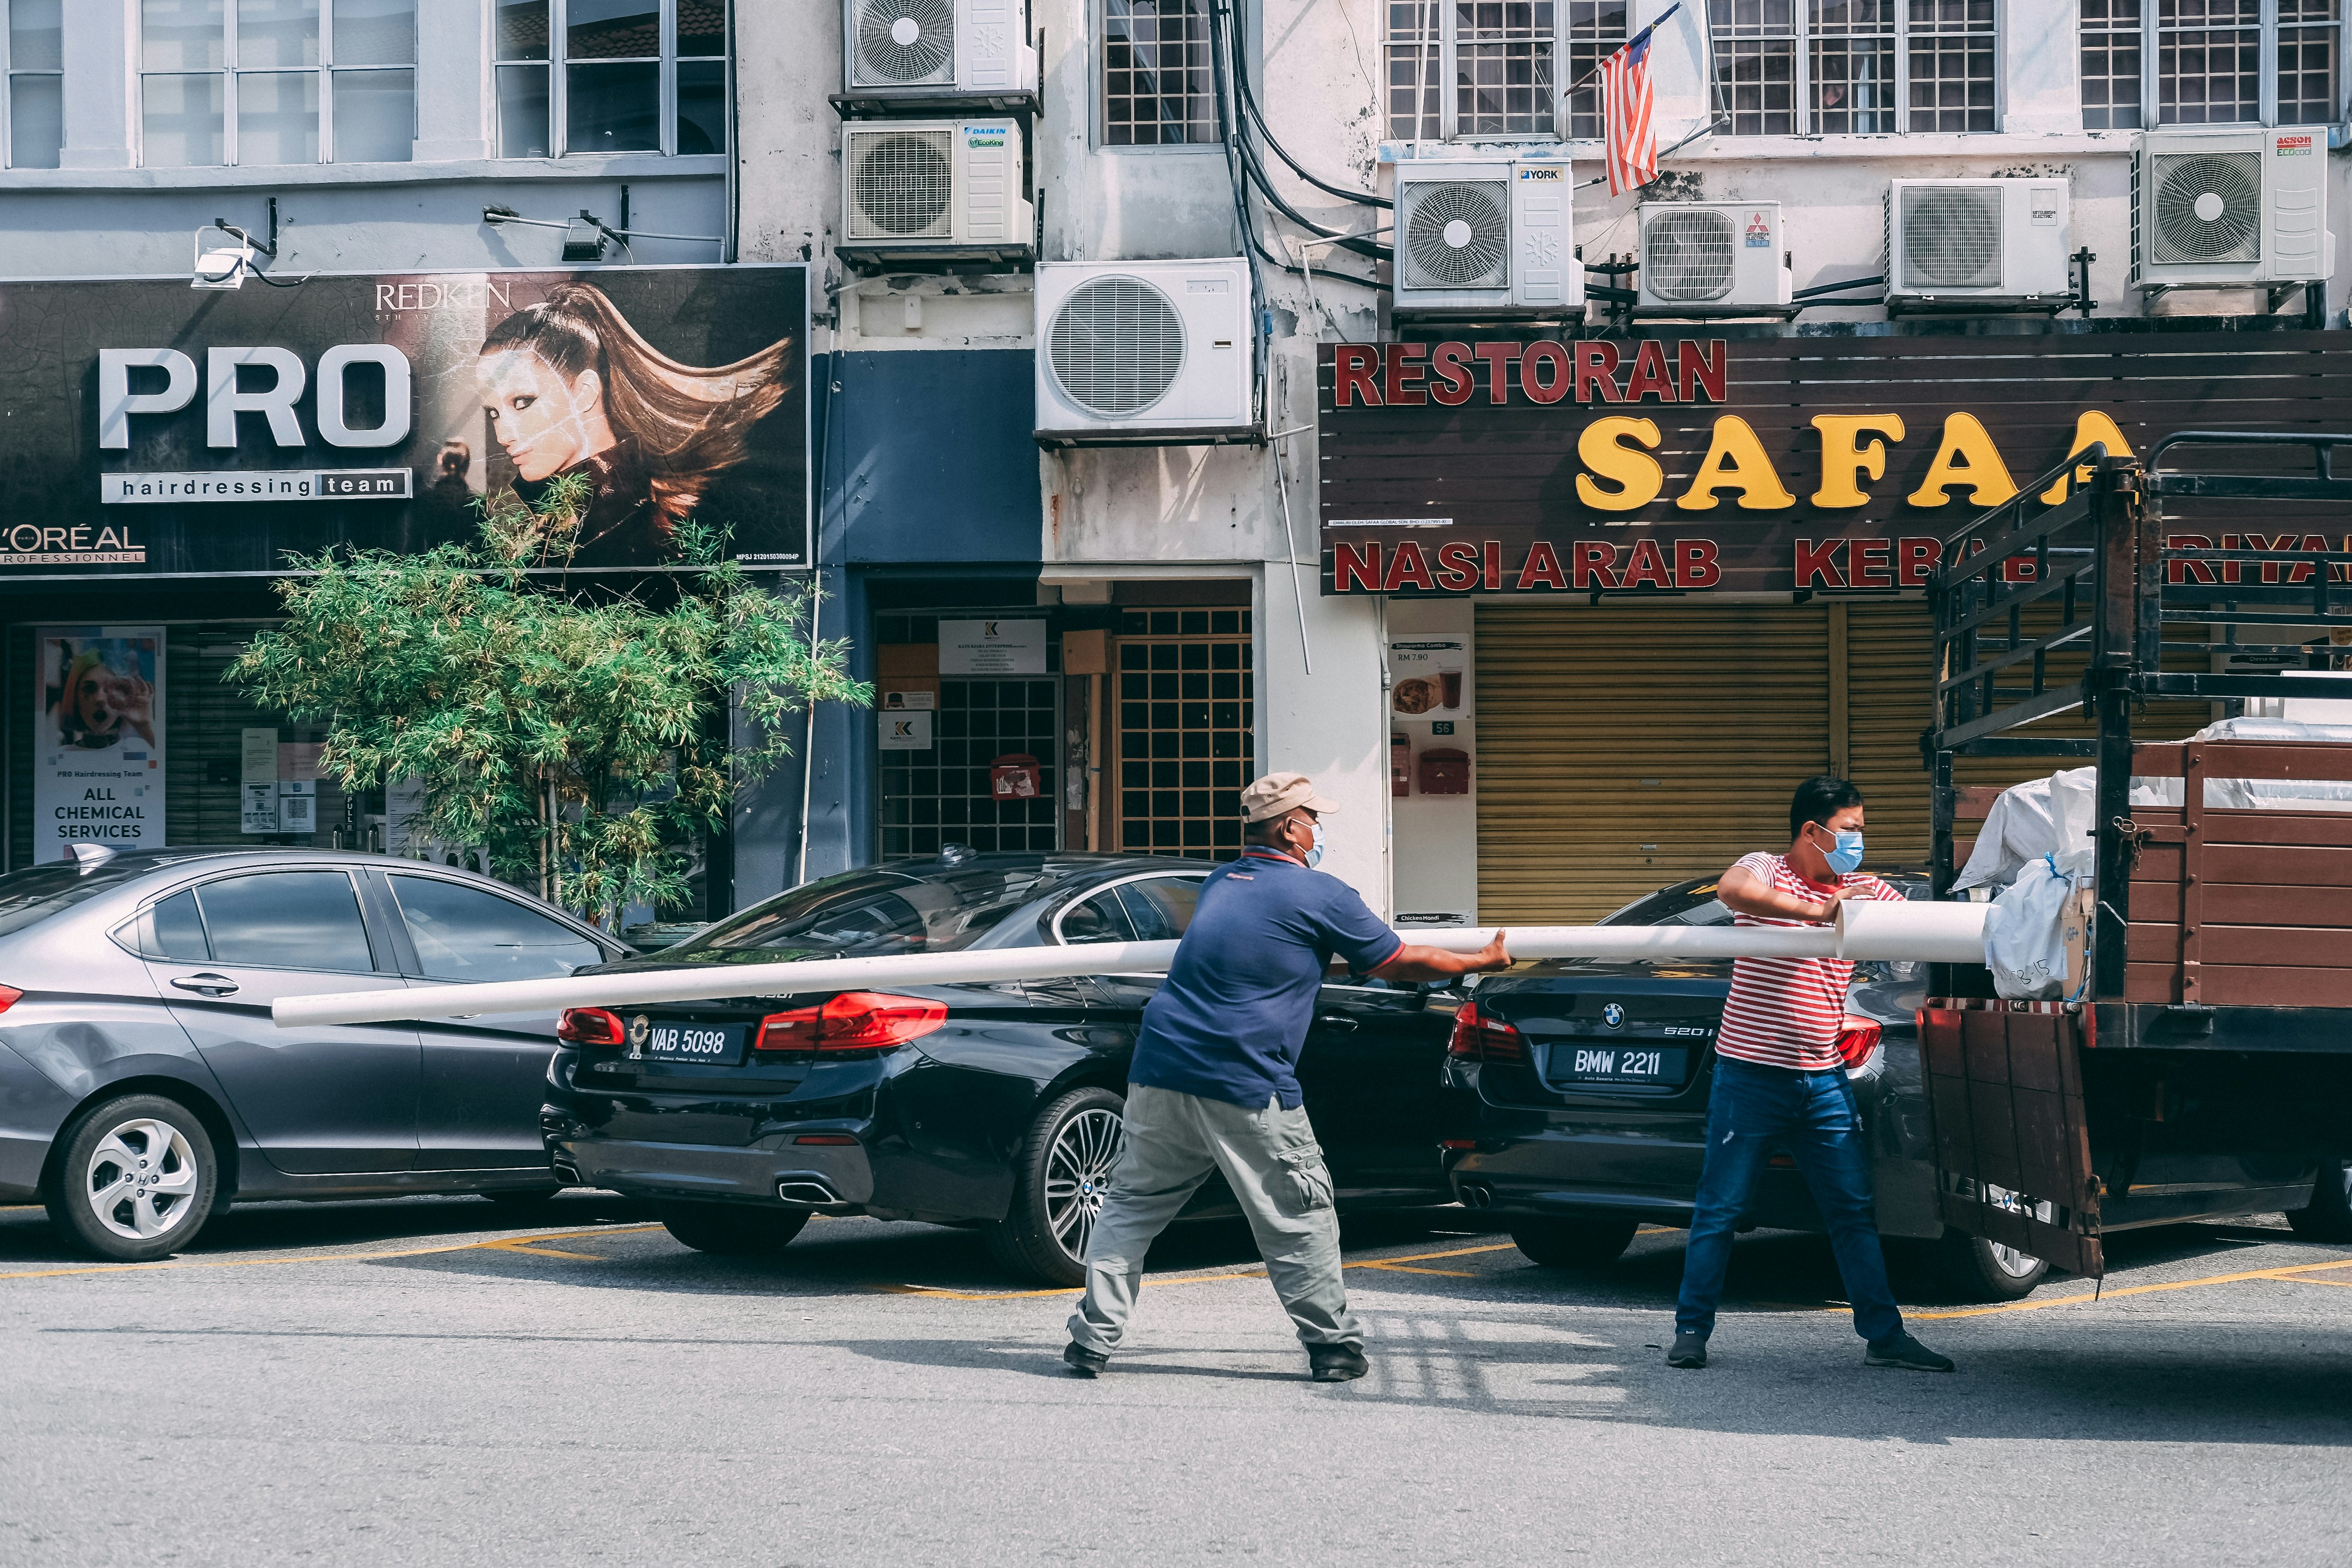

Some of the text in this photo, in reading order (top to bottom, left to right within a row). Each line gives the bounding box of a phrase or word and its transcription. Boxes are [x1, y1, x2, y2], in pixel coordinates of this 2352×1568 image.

[1530, 170, 1559, 179] YORK
[1335, 339, 1727, 406] RESTORAN
[99, 344, 411, 449] PRO
[123, 477, 394, 496] hairdressing team
[1, 553, 143, 563] ROFESSIONNEL
[1335, 541, 1501, 591] NASI
[1517, 539, 1721, 589] ARAB
[1436, 723, 1449, 733] 56
[83, 788, 116, 801] ALL
[54, 806, 145, 819] CHEMICAL
[58, 824, 141, 838] SERVICES
[652, 1028, 725, 1054] VAB 5098
[1575, 1050, 1661, 1075] BMW 2211
